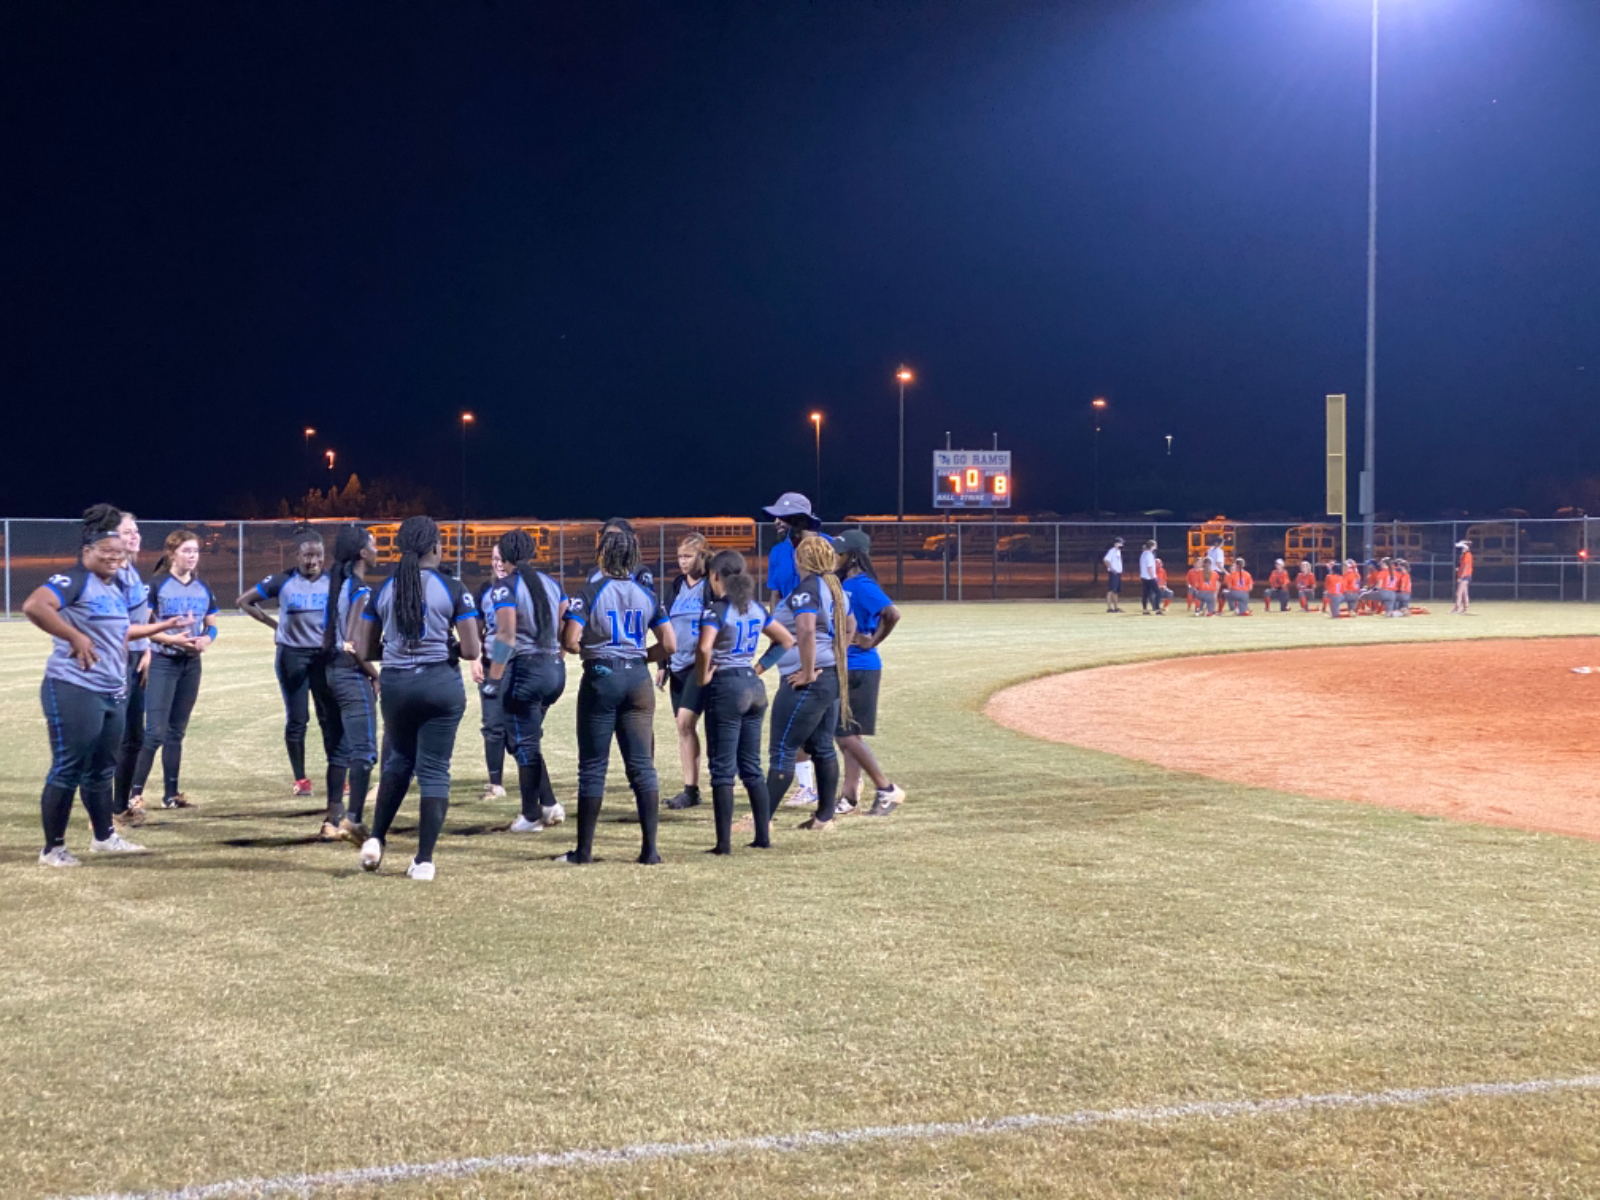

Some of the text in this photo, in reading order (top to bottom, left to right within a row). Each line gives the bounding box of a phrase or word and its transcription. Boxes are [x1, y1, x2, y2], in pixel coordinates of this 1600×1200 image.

[953, 454, 967, 465] GO
[948, 475, 961, 493] 7
[965, 469, 979, 487] 0
[994, 475, 1007, 494] 8
[606, 609, 643, 649] 14
[731, 618, 761, 654] 15
